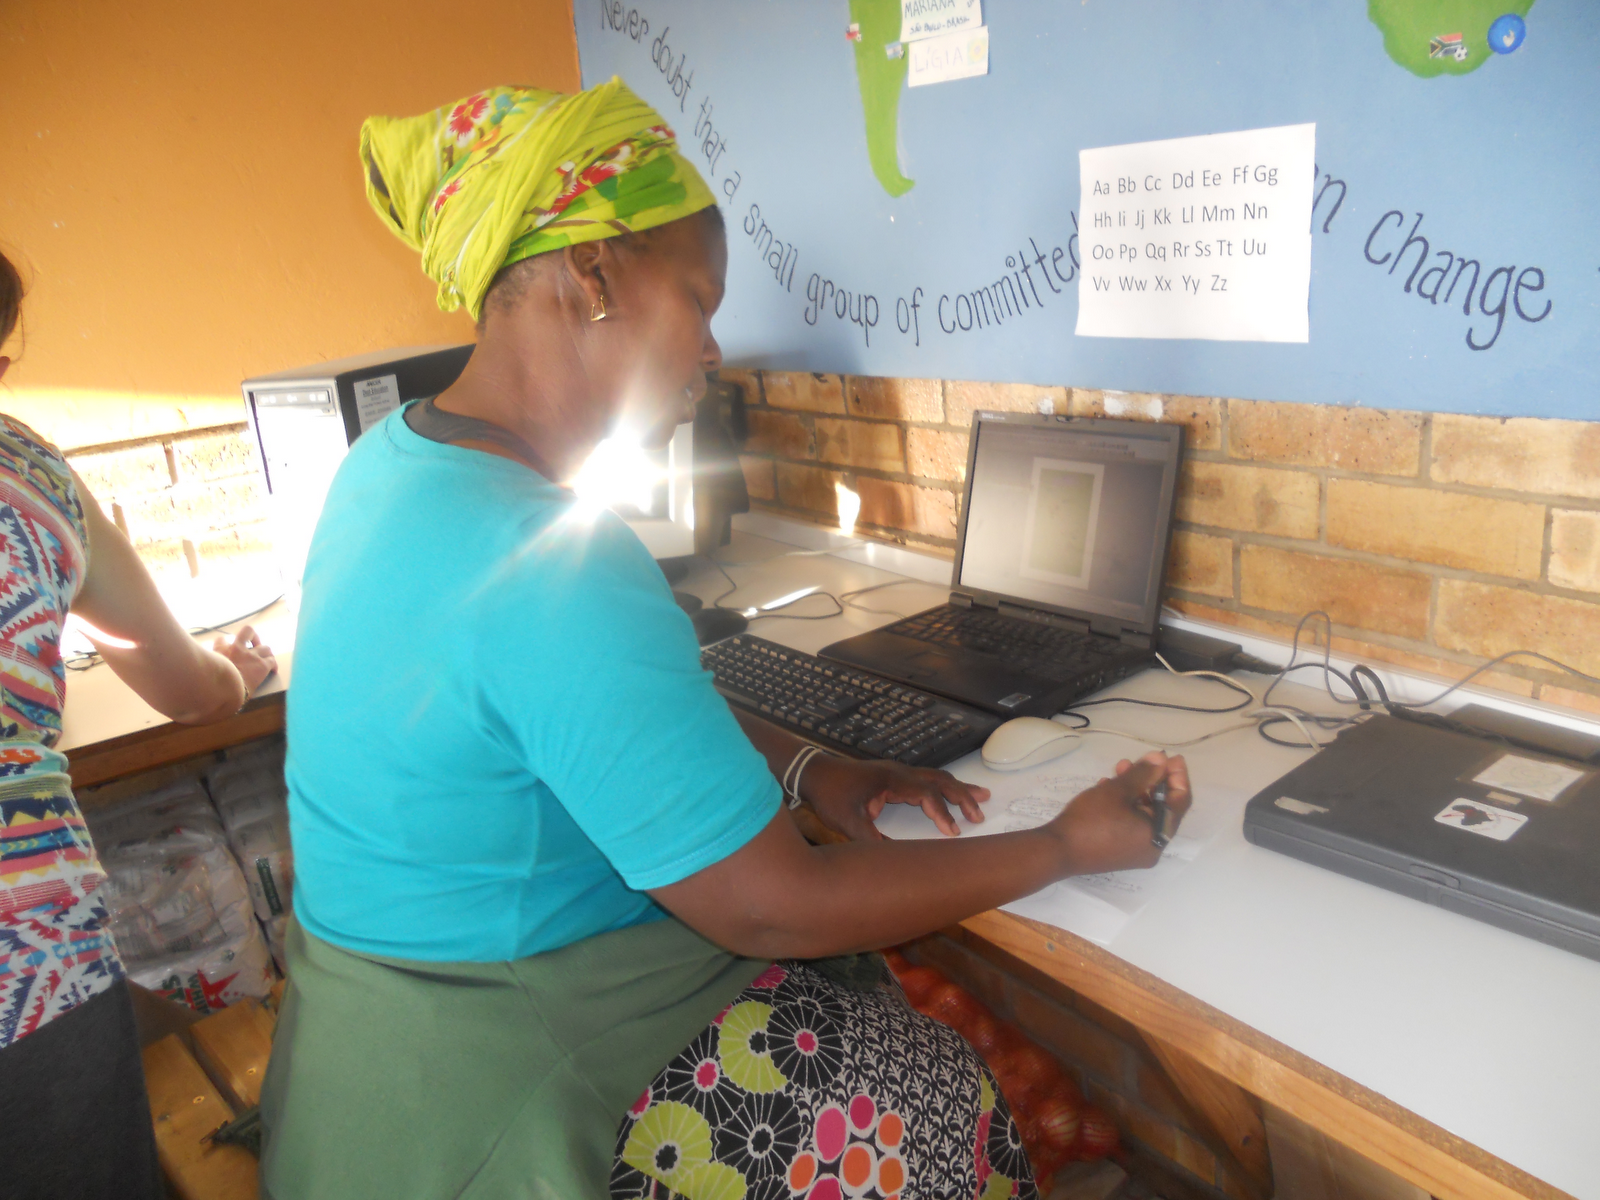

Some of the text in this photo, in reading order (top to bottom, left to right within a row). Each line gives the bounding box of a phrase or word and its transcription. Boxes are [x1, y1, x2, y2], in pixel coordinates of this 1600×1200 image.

[601, 0, 649, 44] Never
[652, 26, 694, 113] doubt
[694, 96, 728, 176] that
[724, 171, 741, 204] a
[744, 204, 798, 292] small
[805, 273, 879, 347] group
[897, 287, 923, 346] of
[1093, 165, 1278, 195] Aa Bb Cc Dd Ee Ff Gg
[1094, 202, 1268, 229] Hh Ii Jj Kk Ll Mm Nn
[1092, 238, 1267, 262] Oo Pp Qq Rr Ss Tt Uu
[1092, 274, 1228, 295] Vv Ww Xx Yy Zz
[187, 974, 212, 1016] WHIT
